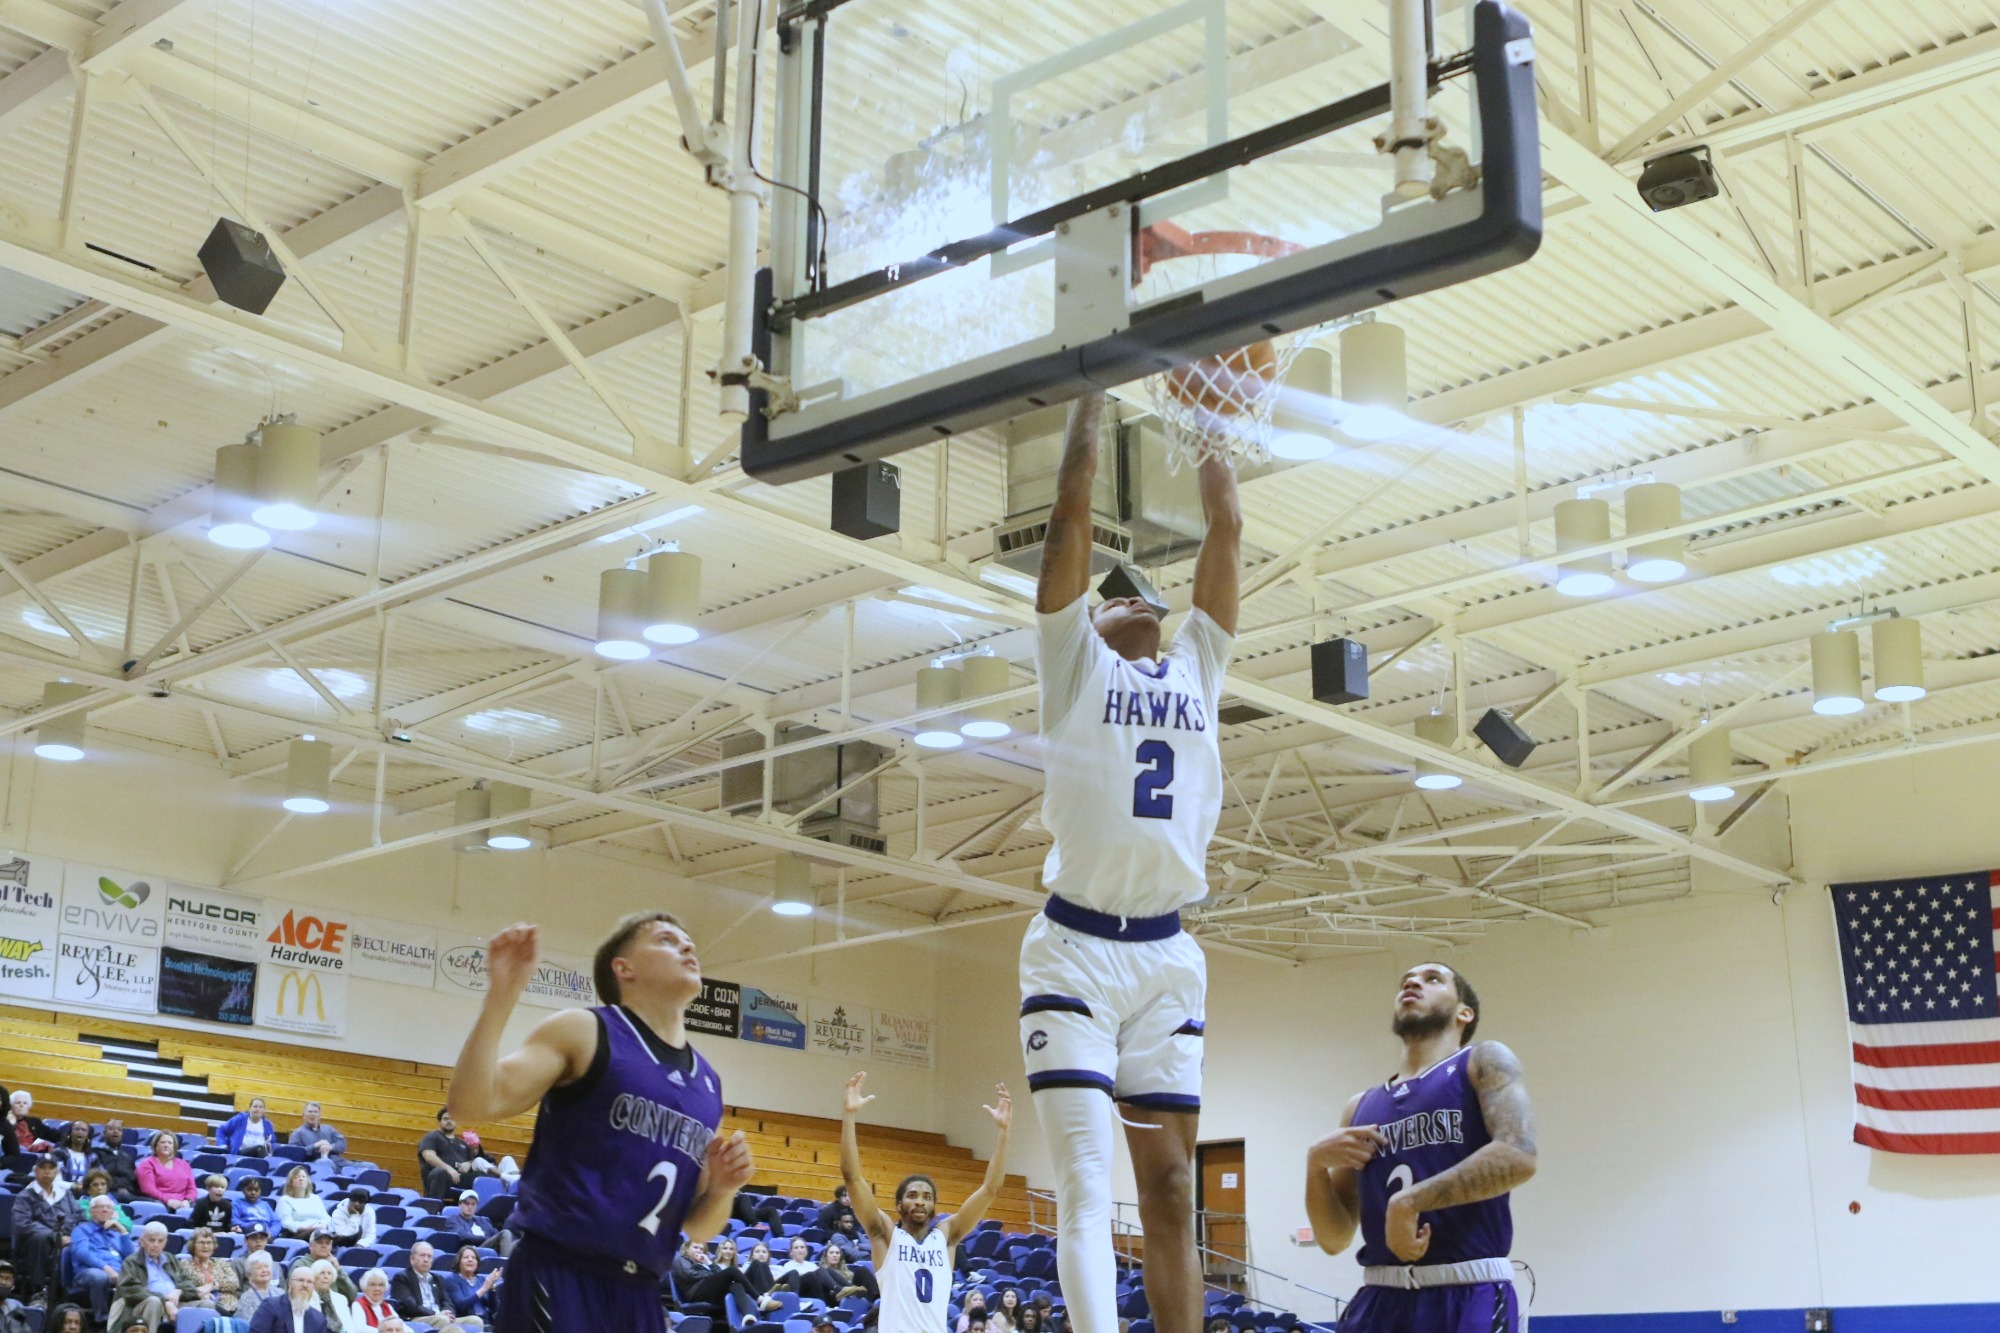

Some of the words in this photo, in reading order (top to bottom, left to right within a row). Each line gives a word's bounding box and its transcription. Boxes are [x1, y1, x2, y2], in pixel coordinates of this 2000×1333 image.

[1102, 689, 1206, 732] HAWKS
[1133, 739, 1175, 820] 2
[12, 886, 53, 909] Tech
[65, 905, 158, 936] enviva
[168, 897, 256, 924] NUCOR
[167, 917, 218, 932] HERTFORD
[222, 926, 259, 938] COUNTY
[266, 908, 348, 954] ACE
[61, 943, 138, 967] REVELLE
[271, 945, 343, 969] Hardware
[363, 937, 390, 952] ECU
[391, 942, 435, 960] HEALTH
[2, 964, 50, 978] fresh.
[95, 965, 129, 985] LEE,
[134, 975, 154, 985] LLP
[164, 956, 192, 973] Boosted
[193, 962, 236, 981] Technologies
[236, 970, 253, 982] LLC
[714, 987, 739, 1004] COIN
[725, 1024, 733, 1032] NC
[815, 1024, 863, 1042] REVELLE
[881, 1013, 931, 1033] ROANOKE
[894, 1027, 929, 1045] VALLEY
[638, 1161, 678, 1237] 2
[898, 1244, 944, 1267] HAWKS
[914, 1268, 934, 1304] 0
